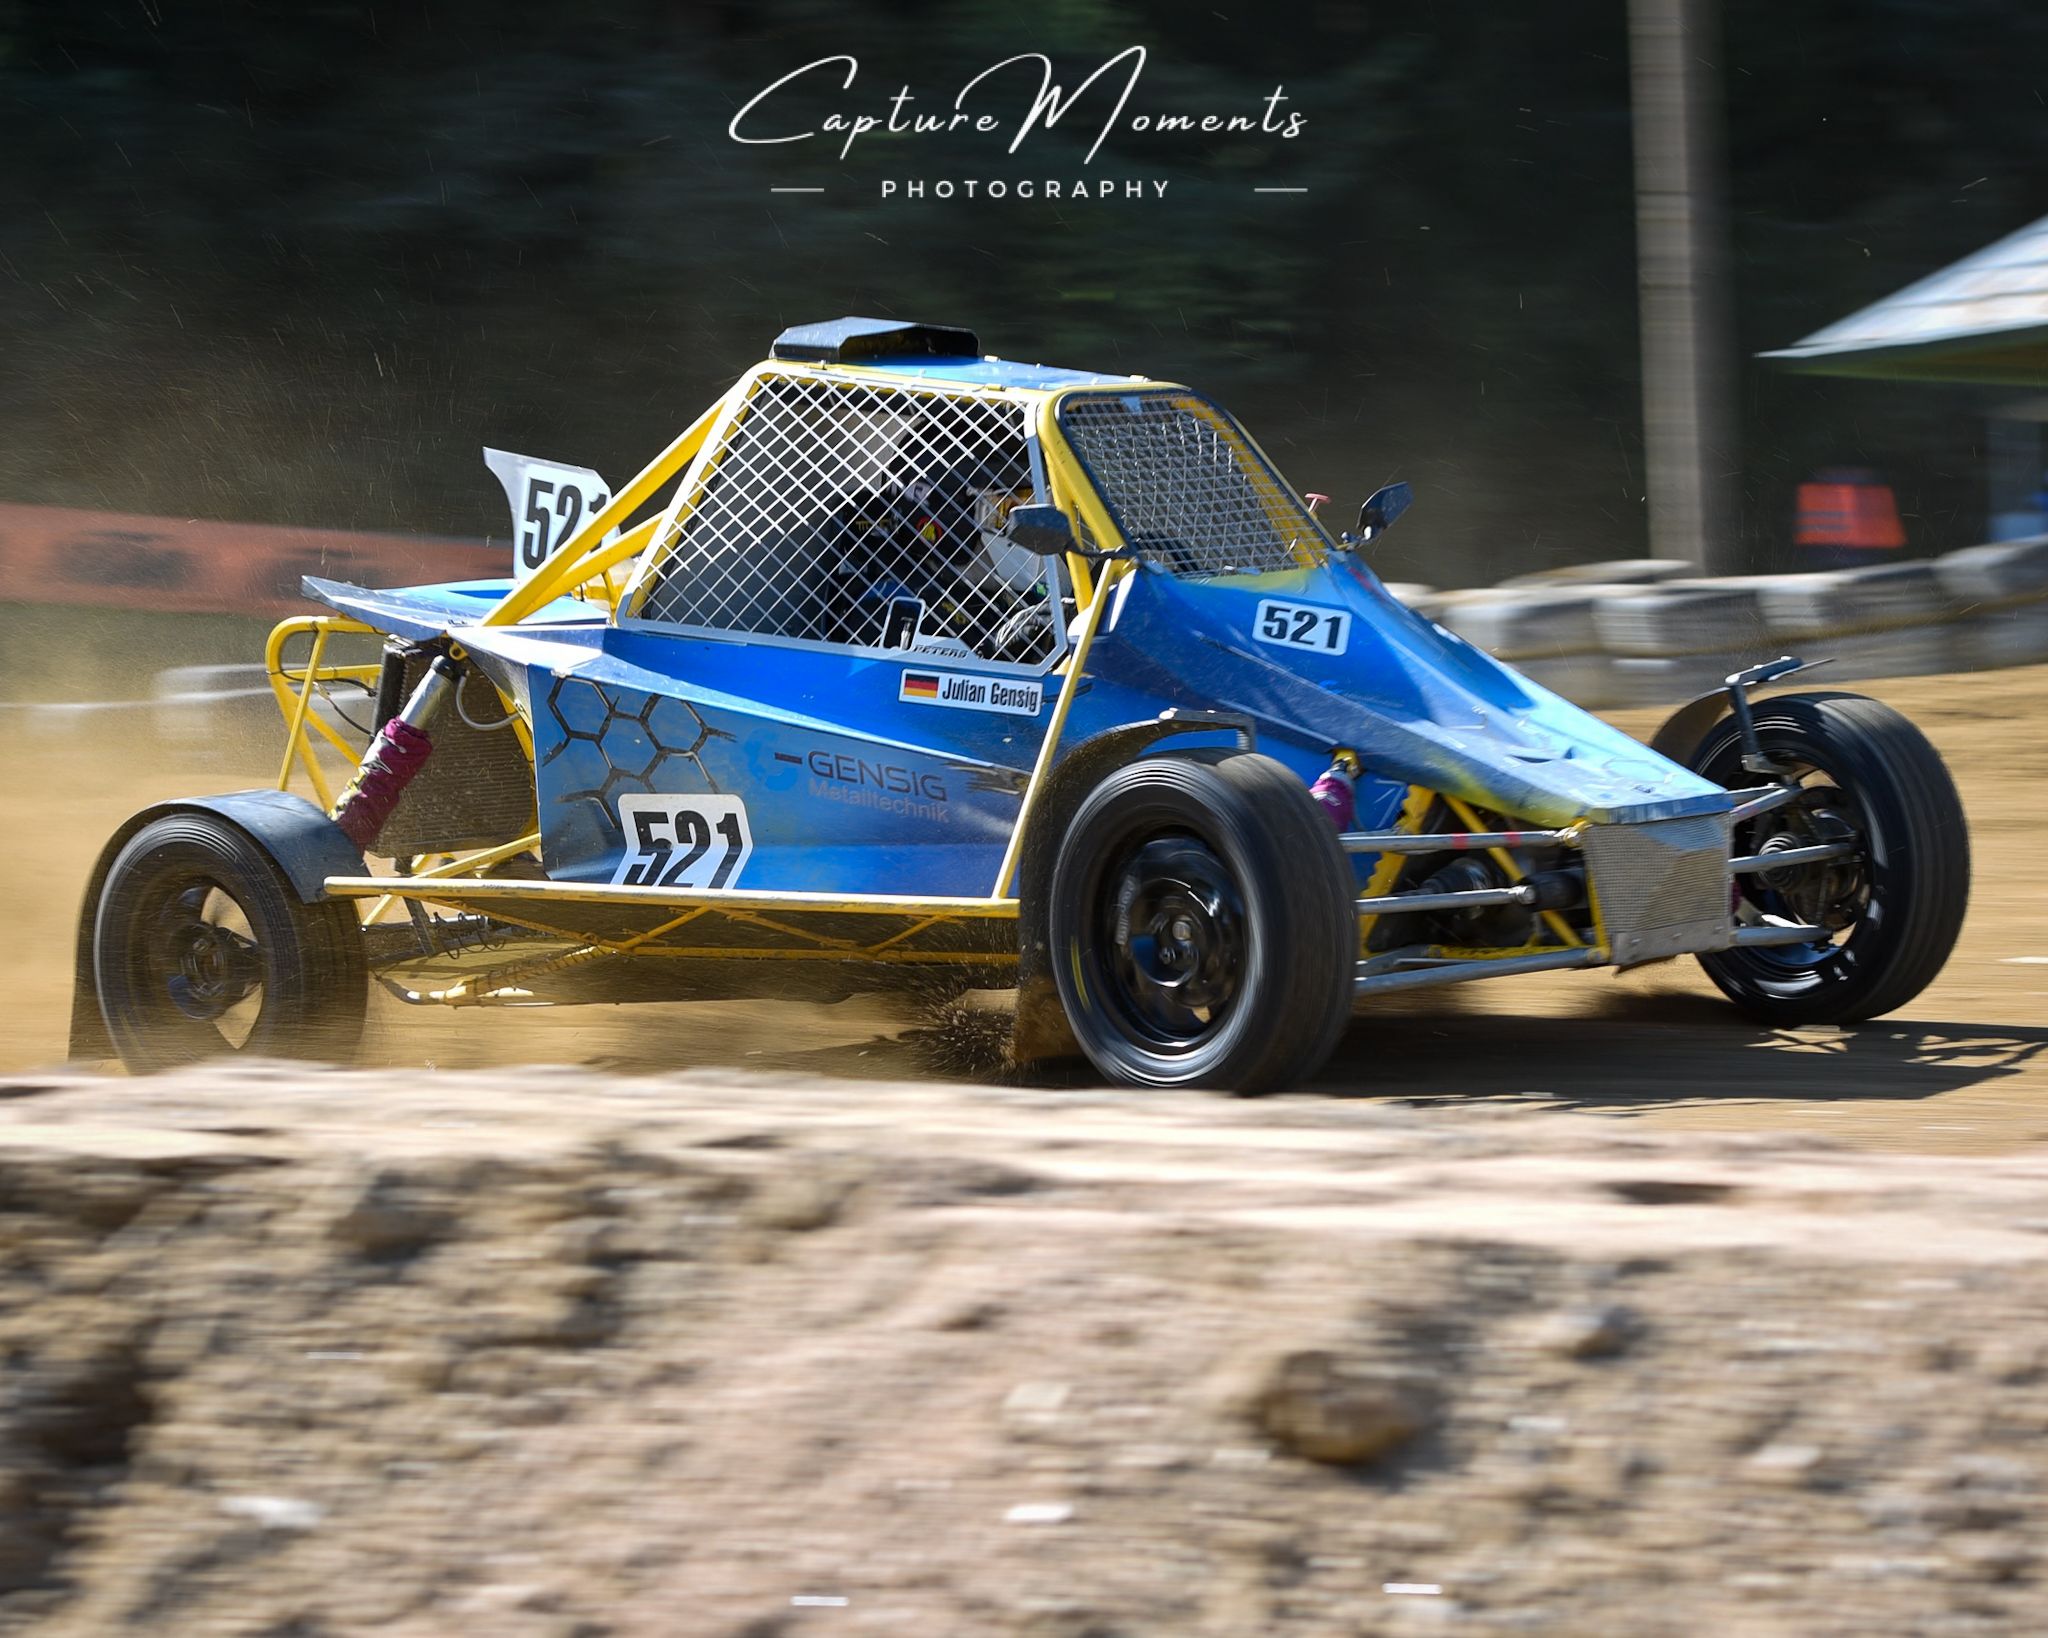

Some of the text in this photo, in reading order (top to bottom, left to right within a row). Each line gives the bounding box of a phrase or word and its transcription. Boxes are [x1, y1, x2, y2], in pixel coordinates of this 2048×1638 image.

[1262, 605, 1343, 649] 521
[942, 678, 1039, 713] Julian Gensig
[808, 750, 948, 801] GENSIG
[622, 810, 743, 889] 521
